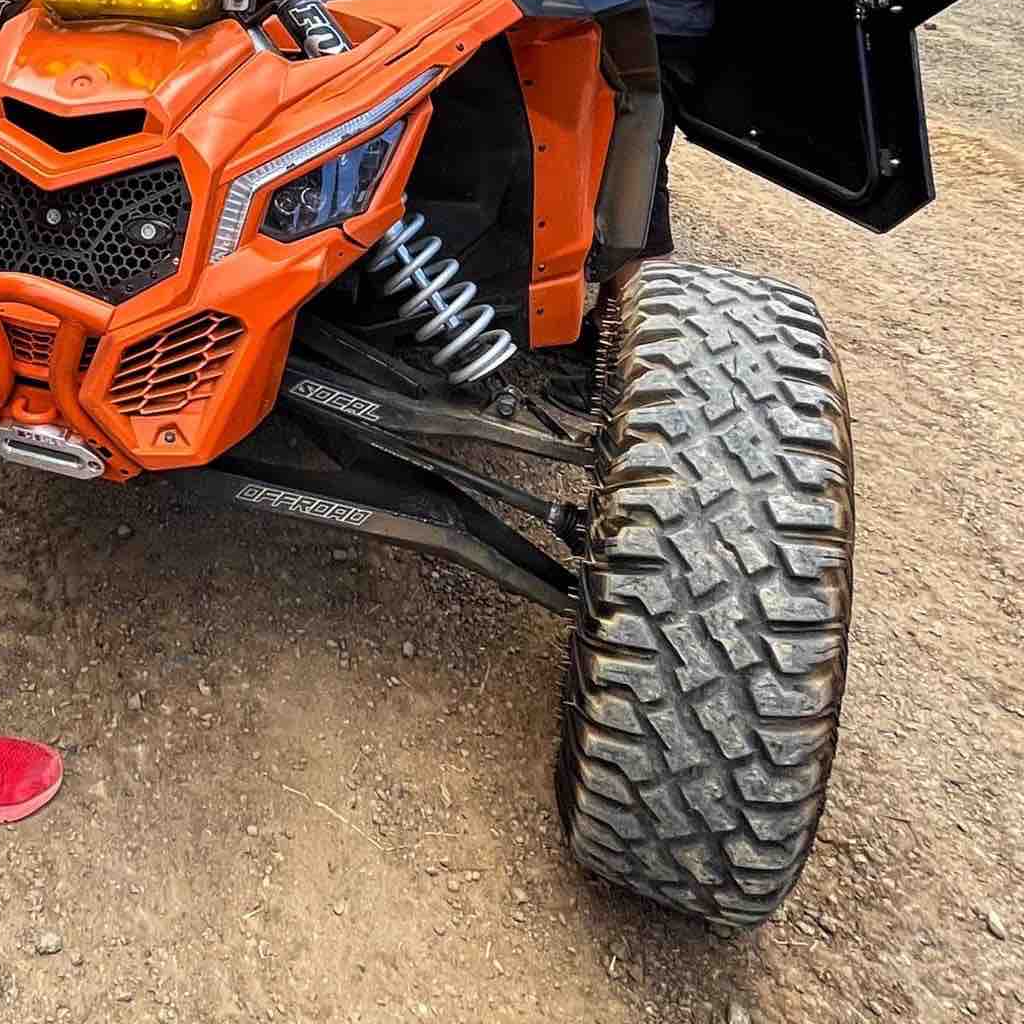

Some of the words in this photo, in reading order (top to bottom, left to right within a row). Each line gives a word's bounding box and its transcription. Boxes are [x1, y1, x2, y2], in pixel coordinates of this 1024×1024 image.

[288, 3, 353, 59] FO
[289, 379, 384, 422] SOCAL
[235, 483, 373, 526] OFFROAD
